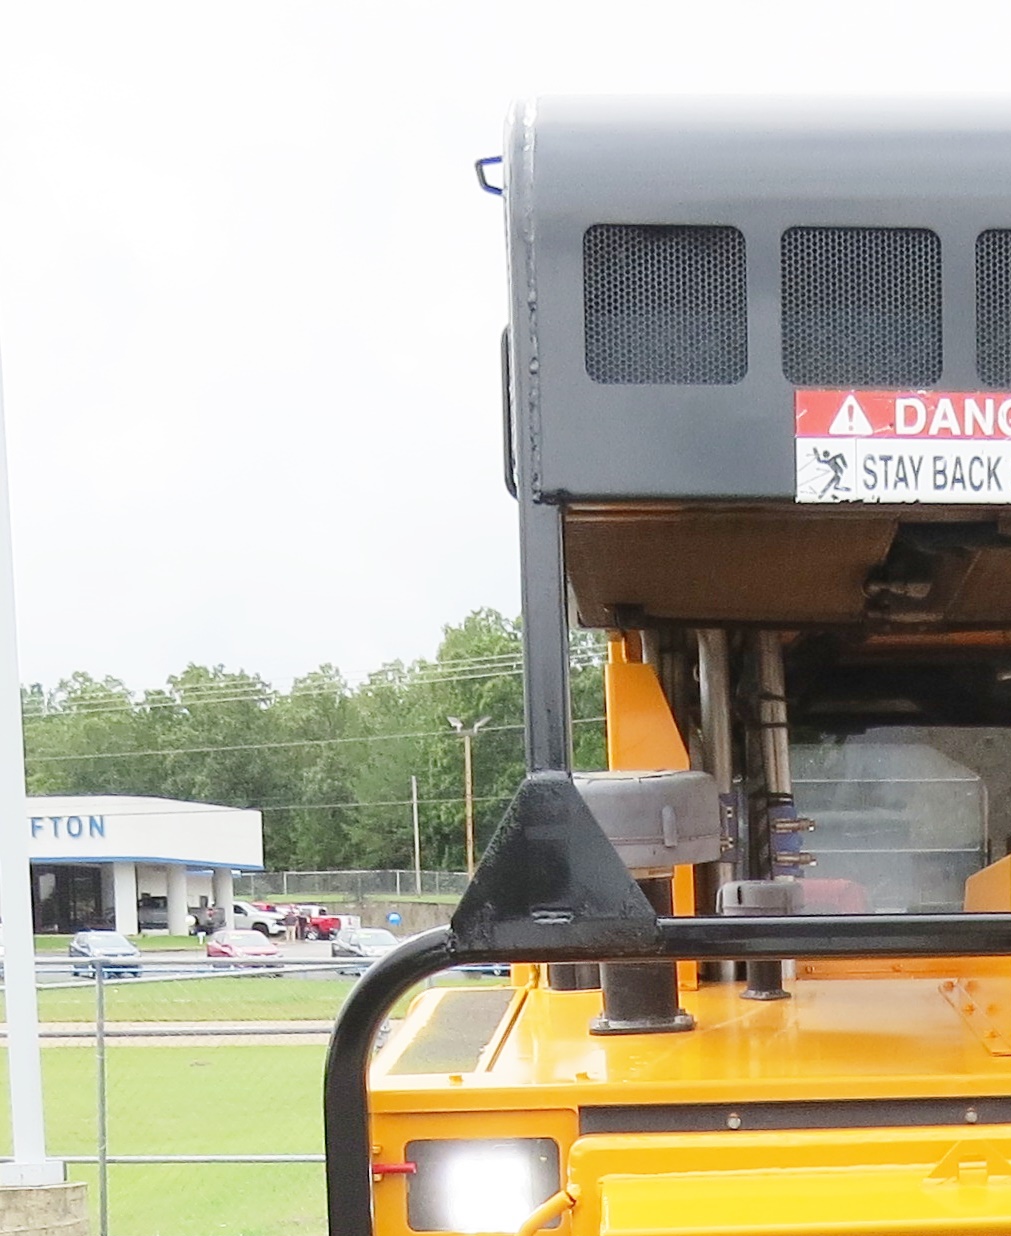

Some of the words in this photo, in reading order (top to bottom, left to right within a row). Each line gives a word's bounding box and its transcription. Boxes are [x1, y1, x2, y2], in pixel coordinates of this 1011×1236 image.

[862, 455, 924, 491] STAY
[932, 456, 1003, 492] BACK
[31, 815, 105, 838] FTON
